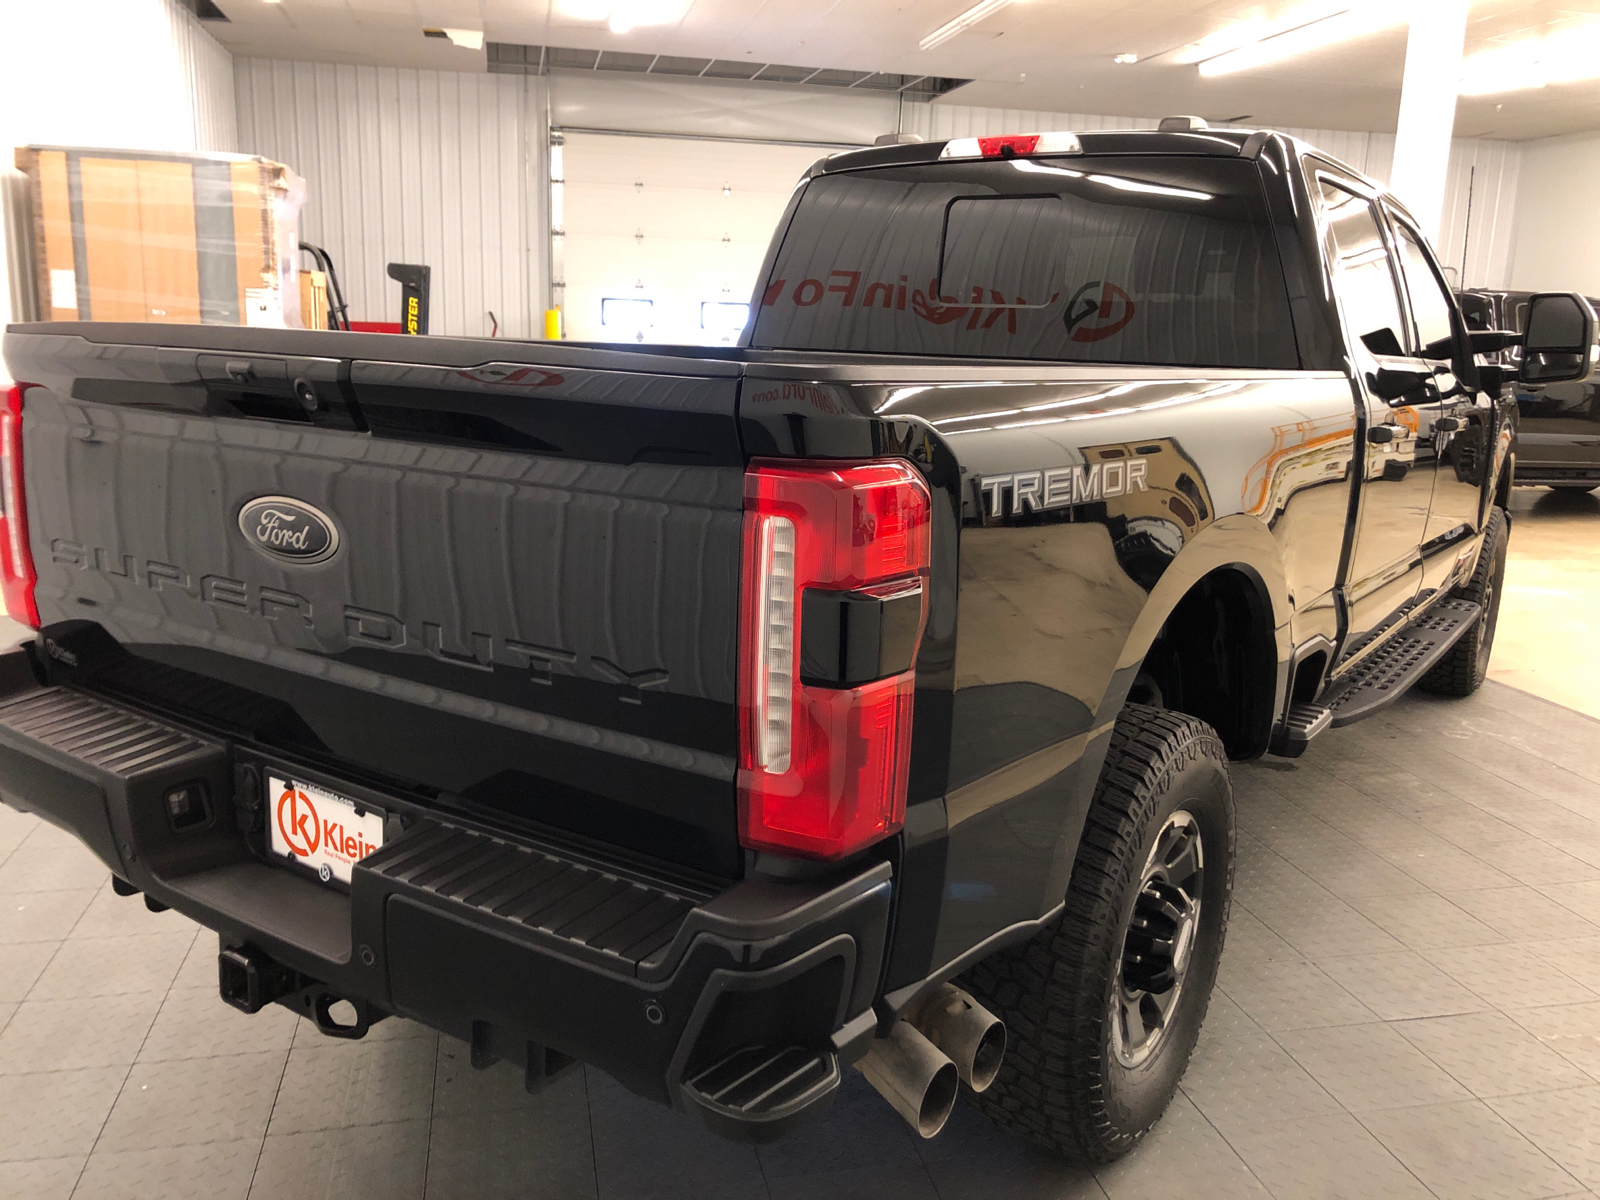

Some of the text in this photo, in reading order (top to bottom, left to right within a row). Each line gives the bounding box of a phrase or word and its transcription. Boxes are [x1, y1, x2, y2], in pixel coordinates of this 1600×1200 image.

[408, 296, 419, 335] YSTER
[981, 457, 1149, 518] TREMOR
[256, 509, 309, 550] Ford
[51, 537, 669, 705] SUPER DUTY
